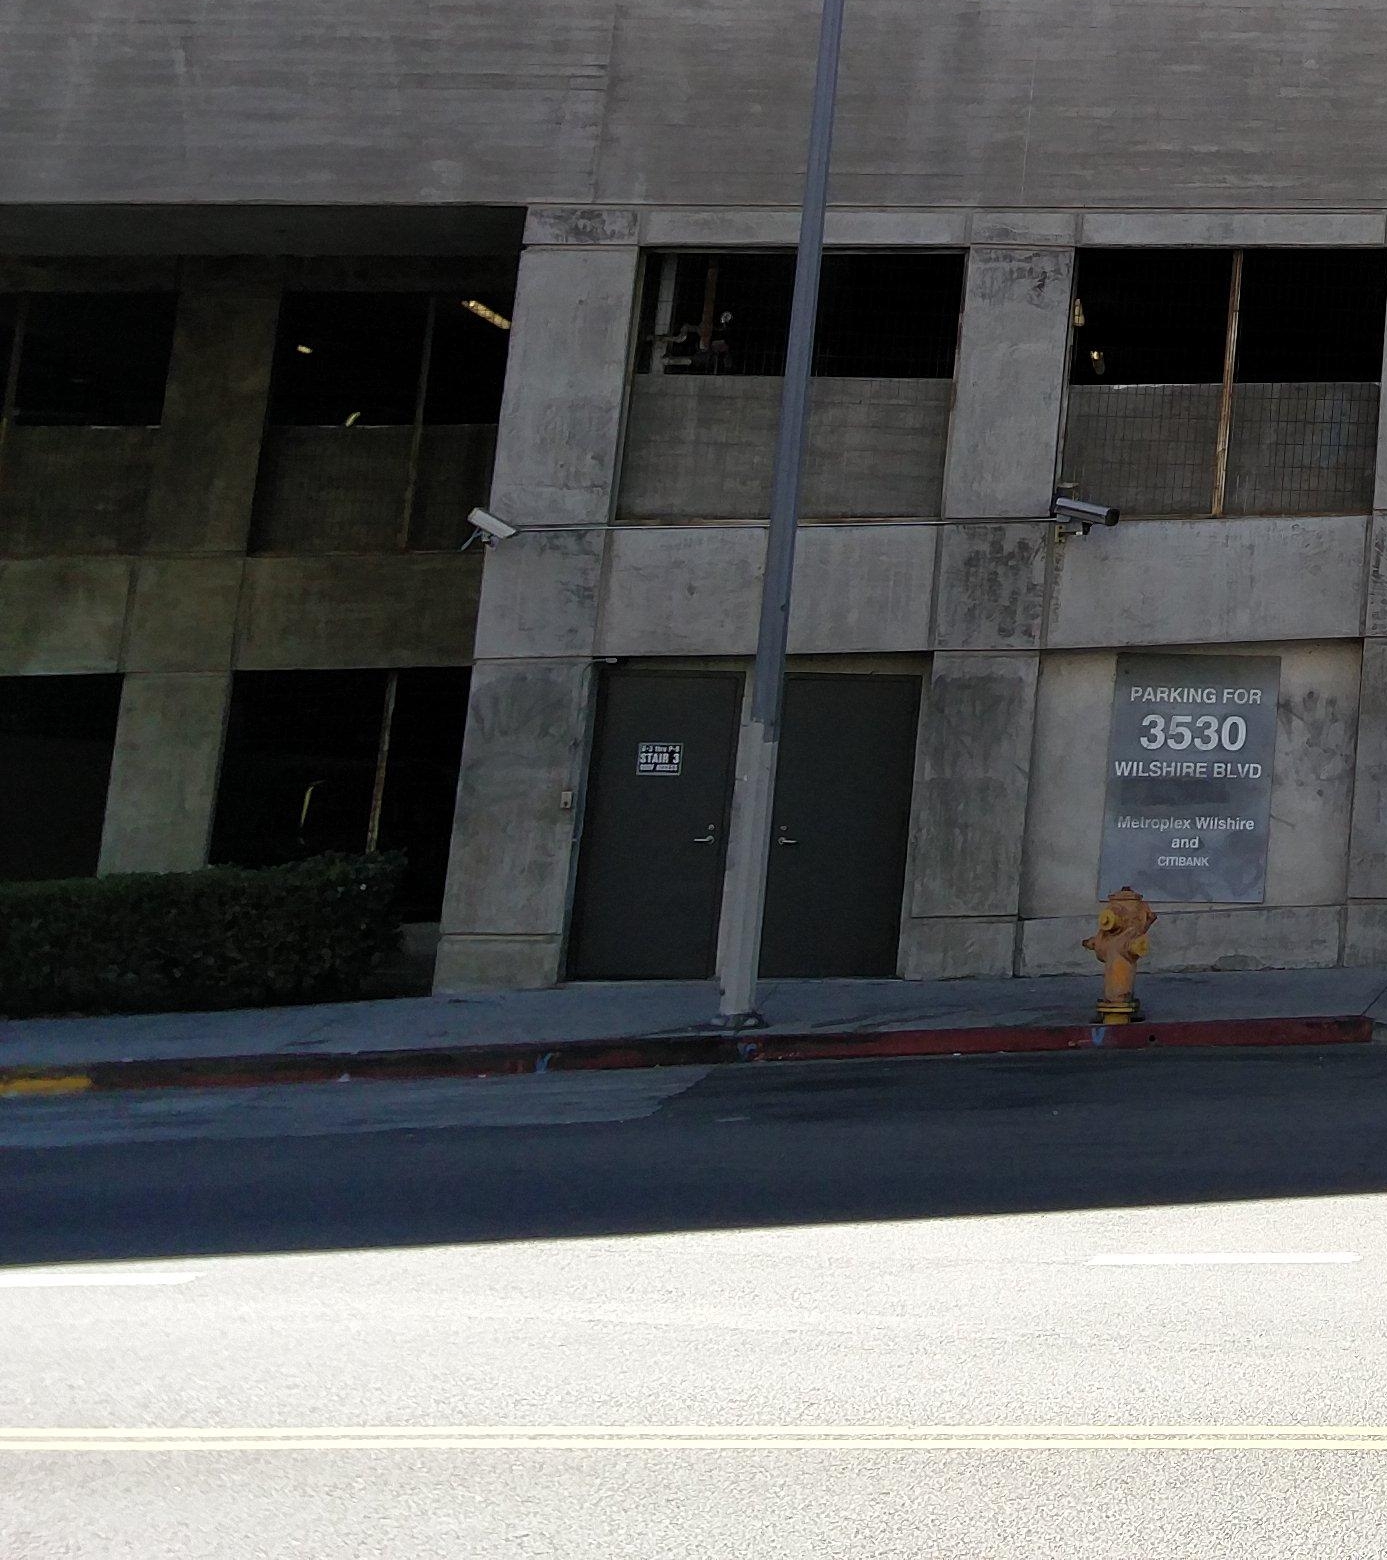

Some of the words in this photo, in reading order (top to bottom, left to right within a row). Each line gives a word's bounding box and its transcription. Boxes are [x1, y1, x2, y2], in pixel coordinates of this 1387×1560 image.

[1130, 686, 1217, 704] PARKING
[1223, 688, 1262, 705] FOR
[1140, 714, 1247, 751] 3530
[640, 753, 669, 763] STAIR
[672, 753, 680, 763] 3
[1115, 760, 1208, 779] WILSHIRE
[1213, 762, 1262, 779] BLVD
[1117, 815, 1191, 831] Metroplex
[1195, 816, 1255, 831] Wilshire
[1171, 836, 1199, 849] and
[1157, 856, 1210, 867] CITIBANK
